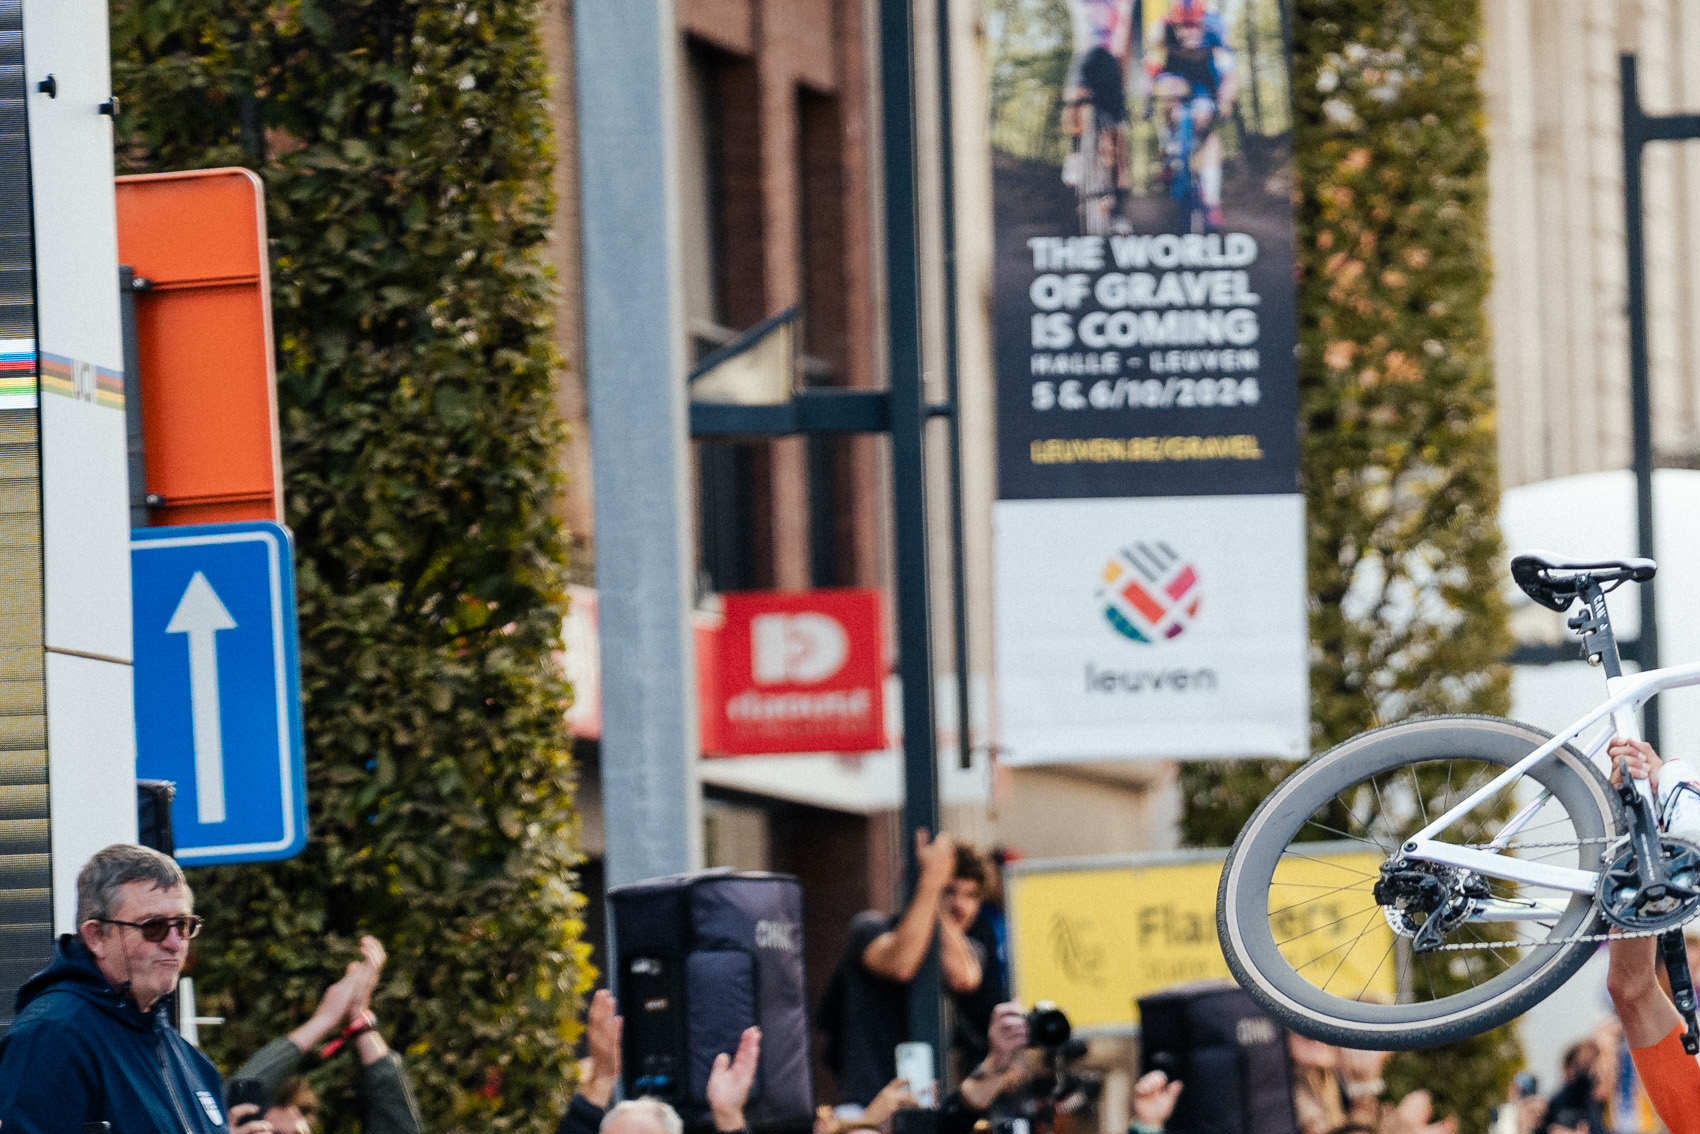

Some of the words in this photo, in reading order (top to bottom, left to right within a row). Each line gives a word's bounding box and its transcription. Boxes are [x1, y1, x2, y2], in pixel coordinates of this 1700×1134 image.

[1026, 235, 1105, 271] THE
[1109, 232, 1259, 269] WORLD
[1029, 272, 1091, 311] OF
[1094, 269, 1262, 309] GRAVEL
[1030, 311, 1075, 350] IS
[1077, 307, 1261, 349] COMING
[1030, 350, 1121, 376] HALLE
[1148, 349, 1261, 374] LEUVEN
[1031, 380, 1057, 411] 5
[1057, 379, 1088, 410] &
[1088, 375, 1261, 410] 6/10/2024
[1029, 434, 1265, 465] LEUVEN.BE/GRAVEL
[1085, 661, 1219, 694] leuven
